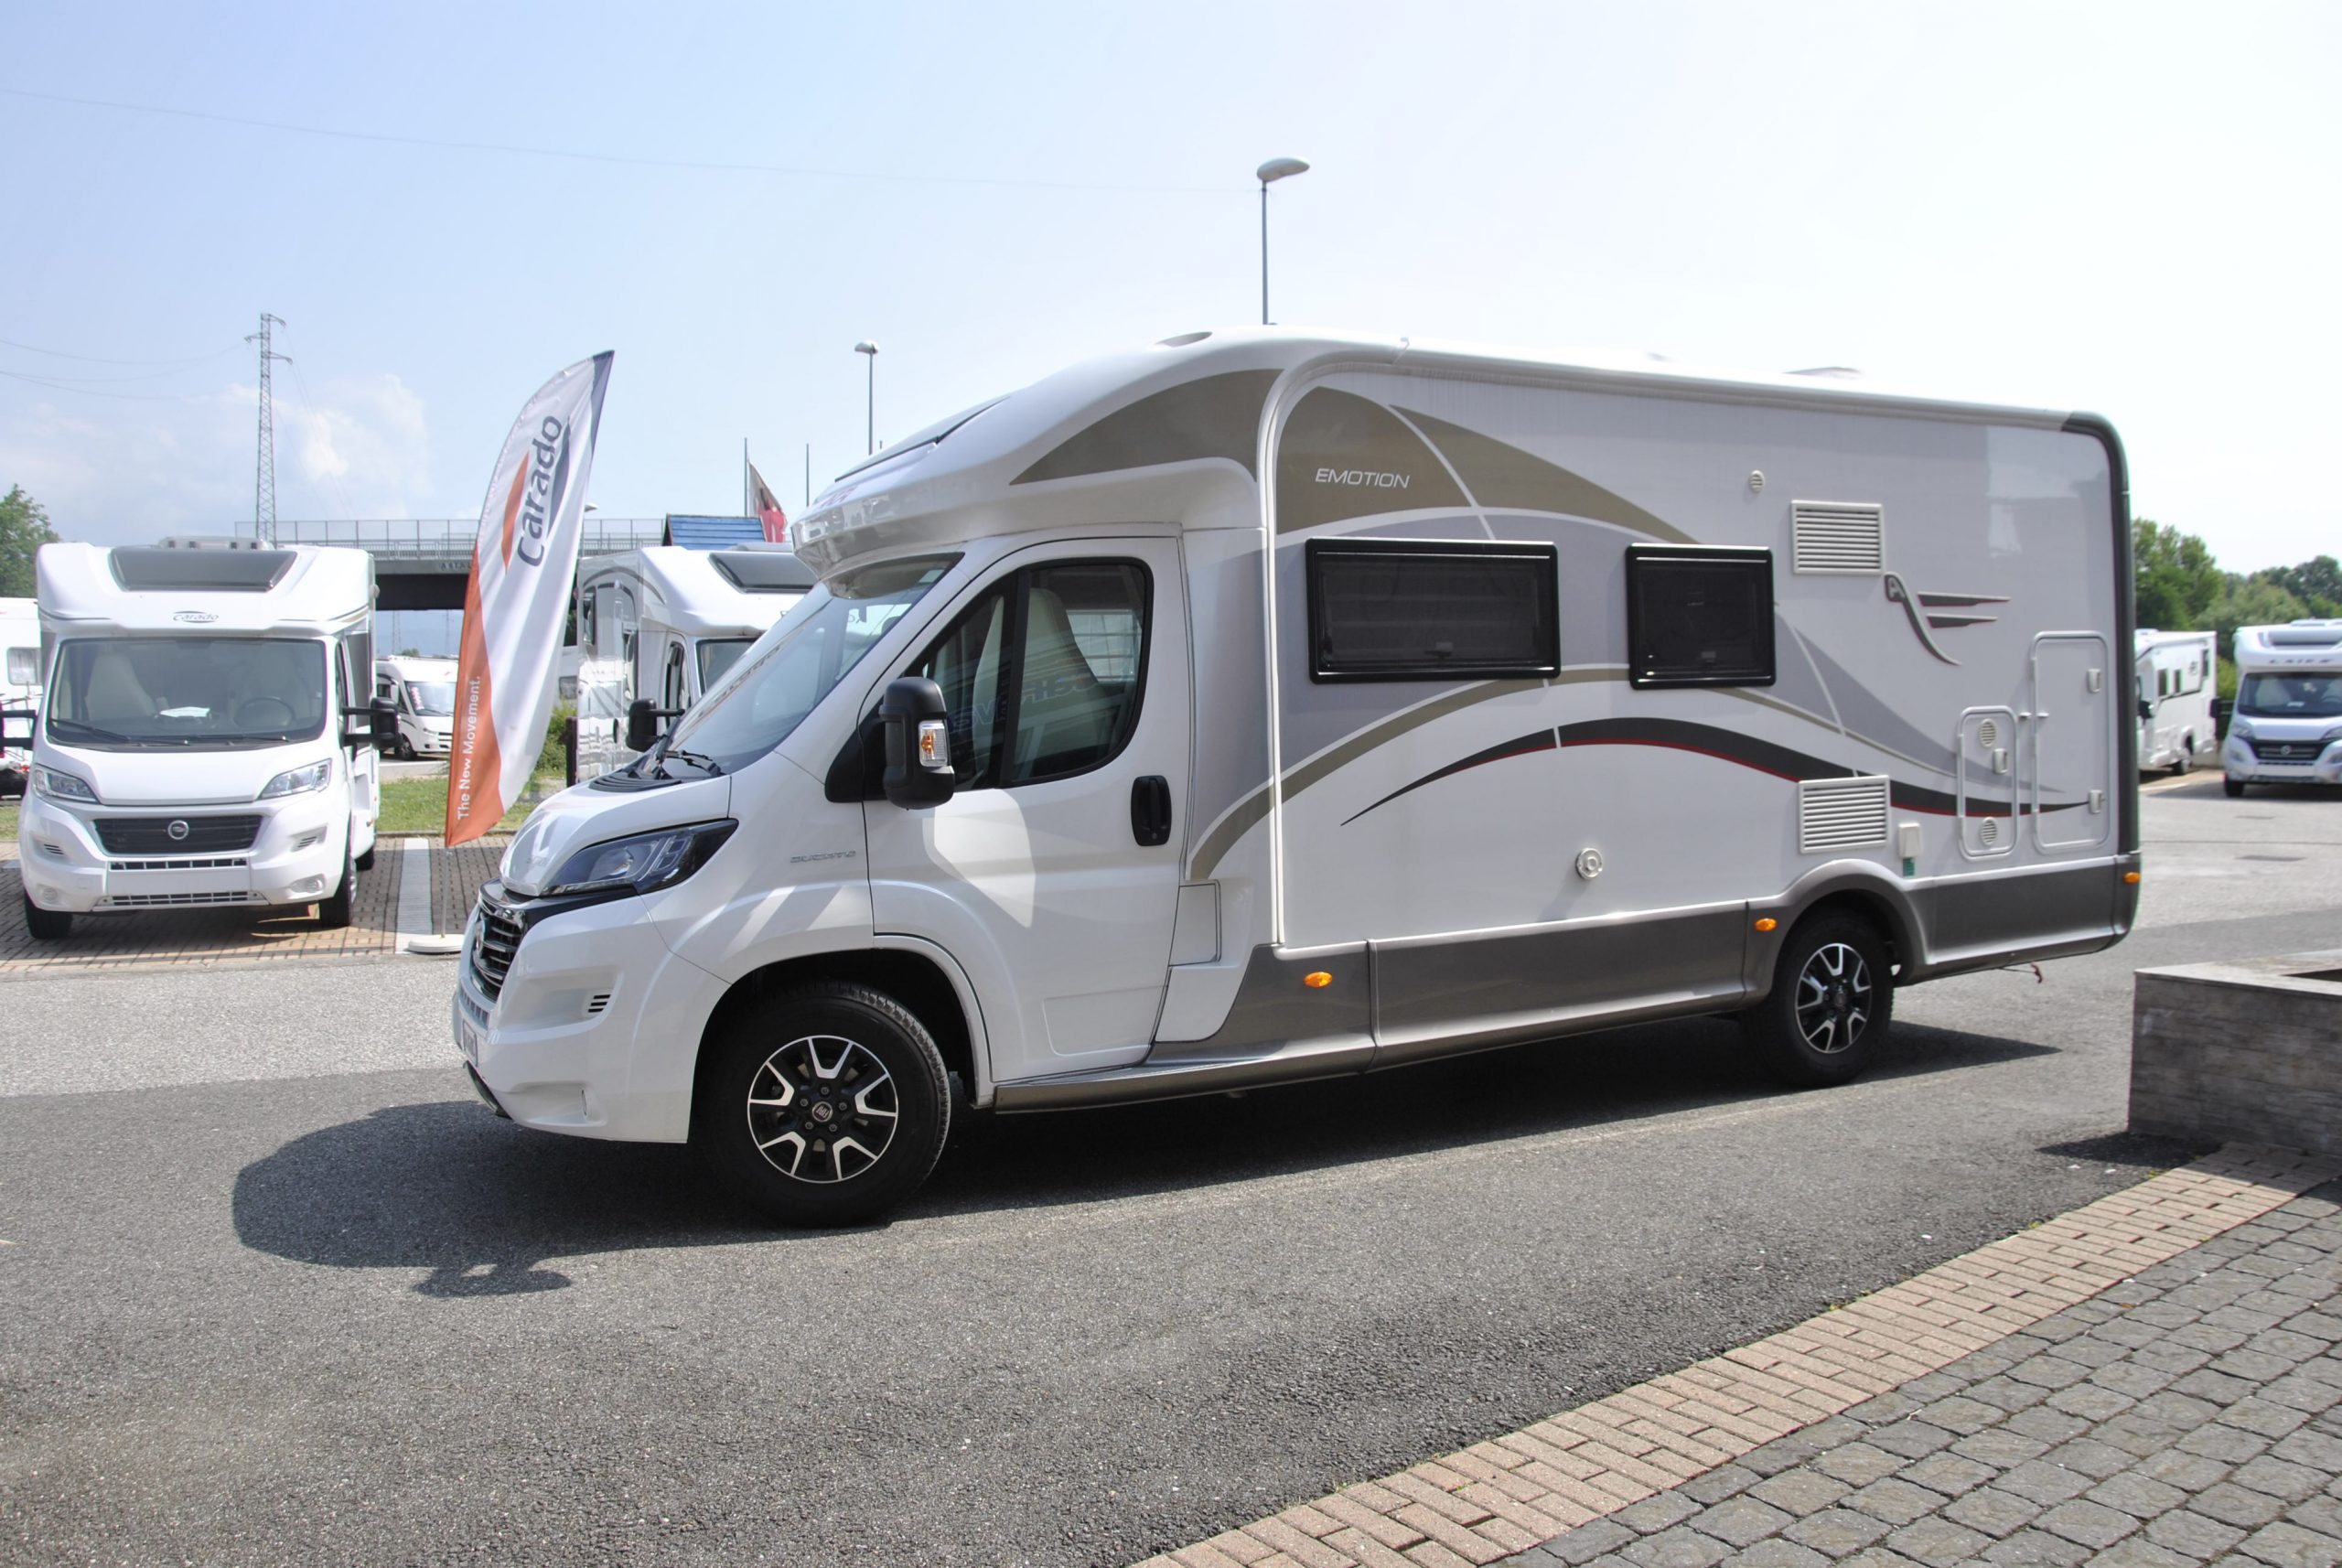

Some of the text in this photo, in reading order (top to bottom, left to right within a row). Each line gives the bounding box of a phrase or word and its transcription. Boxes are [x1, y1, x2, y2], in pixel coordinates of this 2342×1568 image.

[517, 415, 563, 567] Carado
[1315, 467, 1411, 489] EMOTION
[457, 675, 481, 820] The New Movement.
